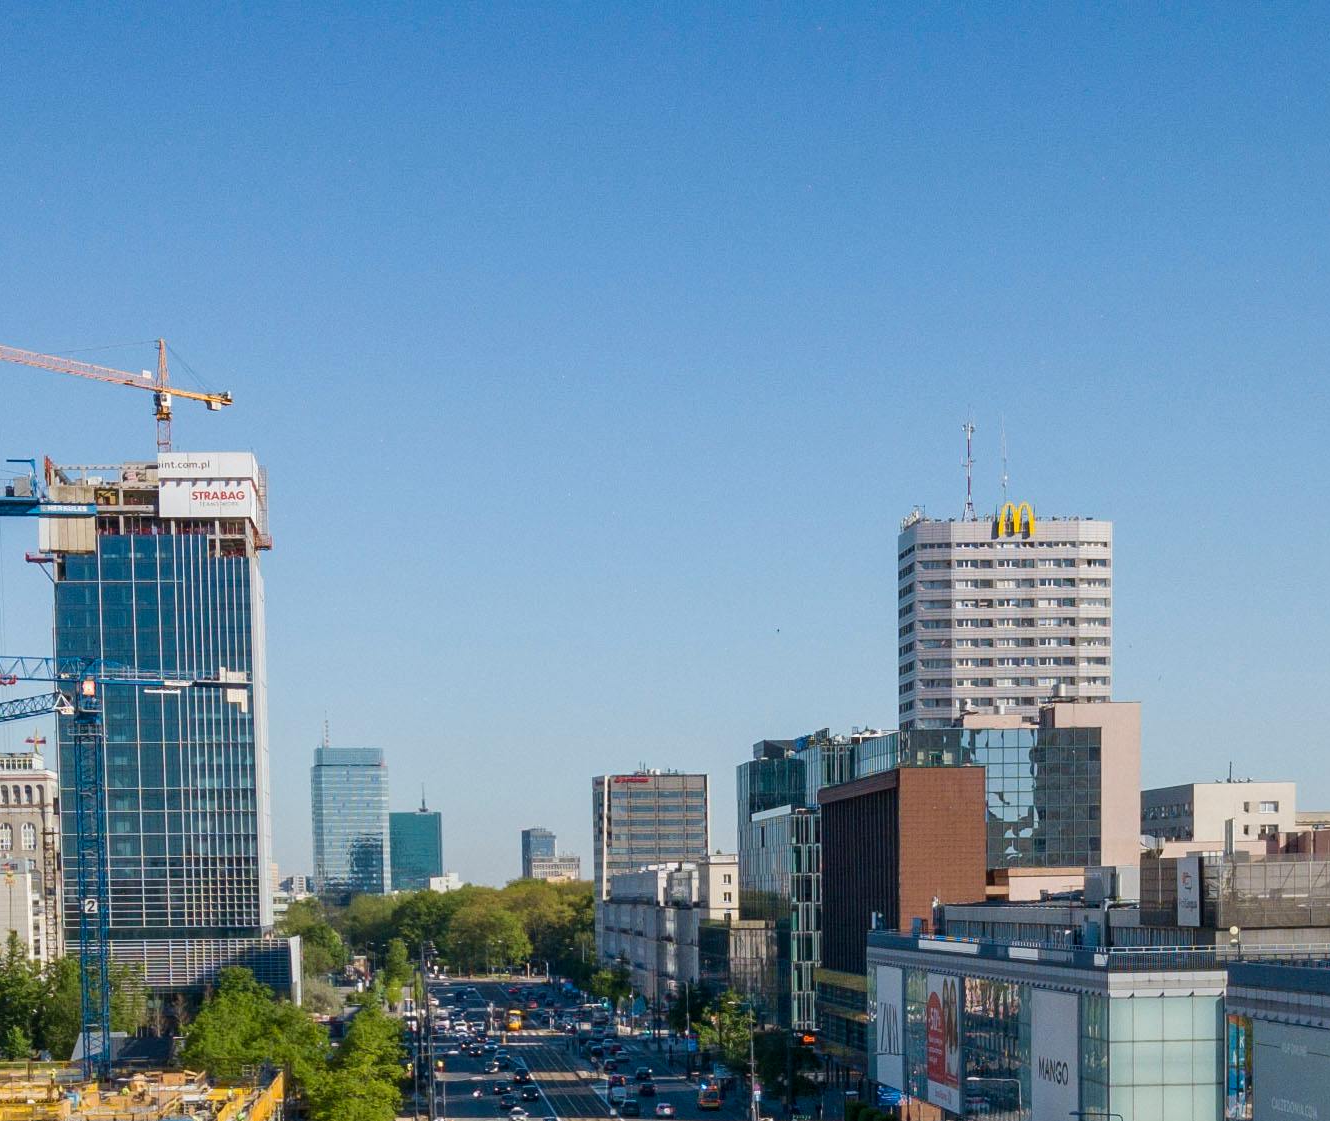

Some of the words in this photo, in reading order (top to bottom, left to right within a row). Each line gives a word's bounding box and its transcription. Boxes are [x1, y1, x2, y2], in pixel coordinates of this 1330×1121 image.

[192, 491, 245, 501] STRABAG
[86, 900, 95, 912] 2
[1038, 1056, 1069, 1086] MANGO
